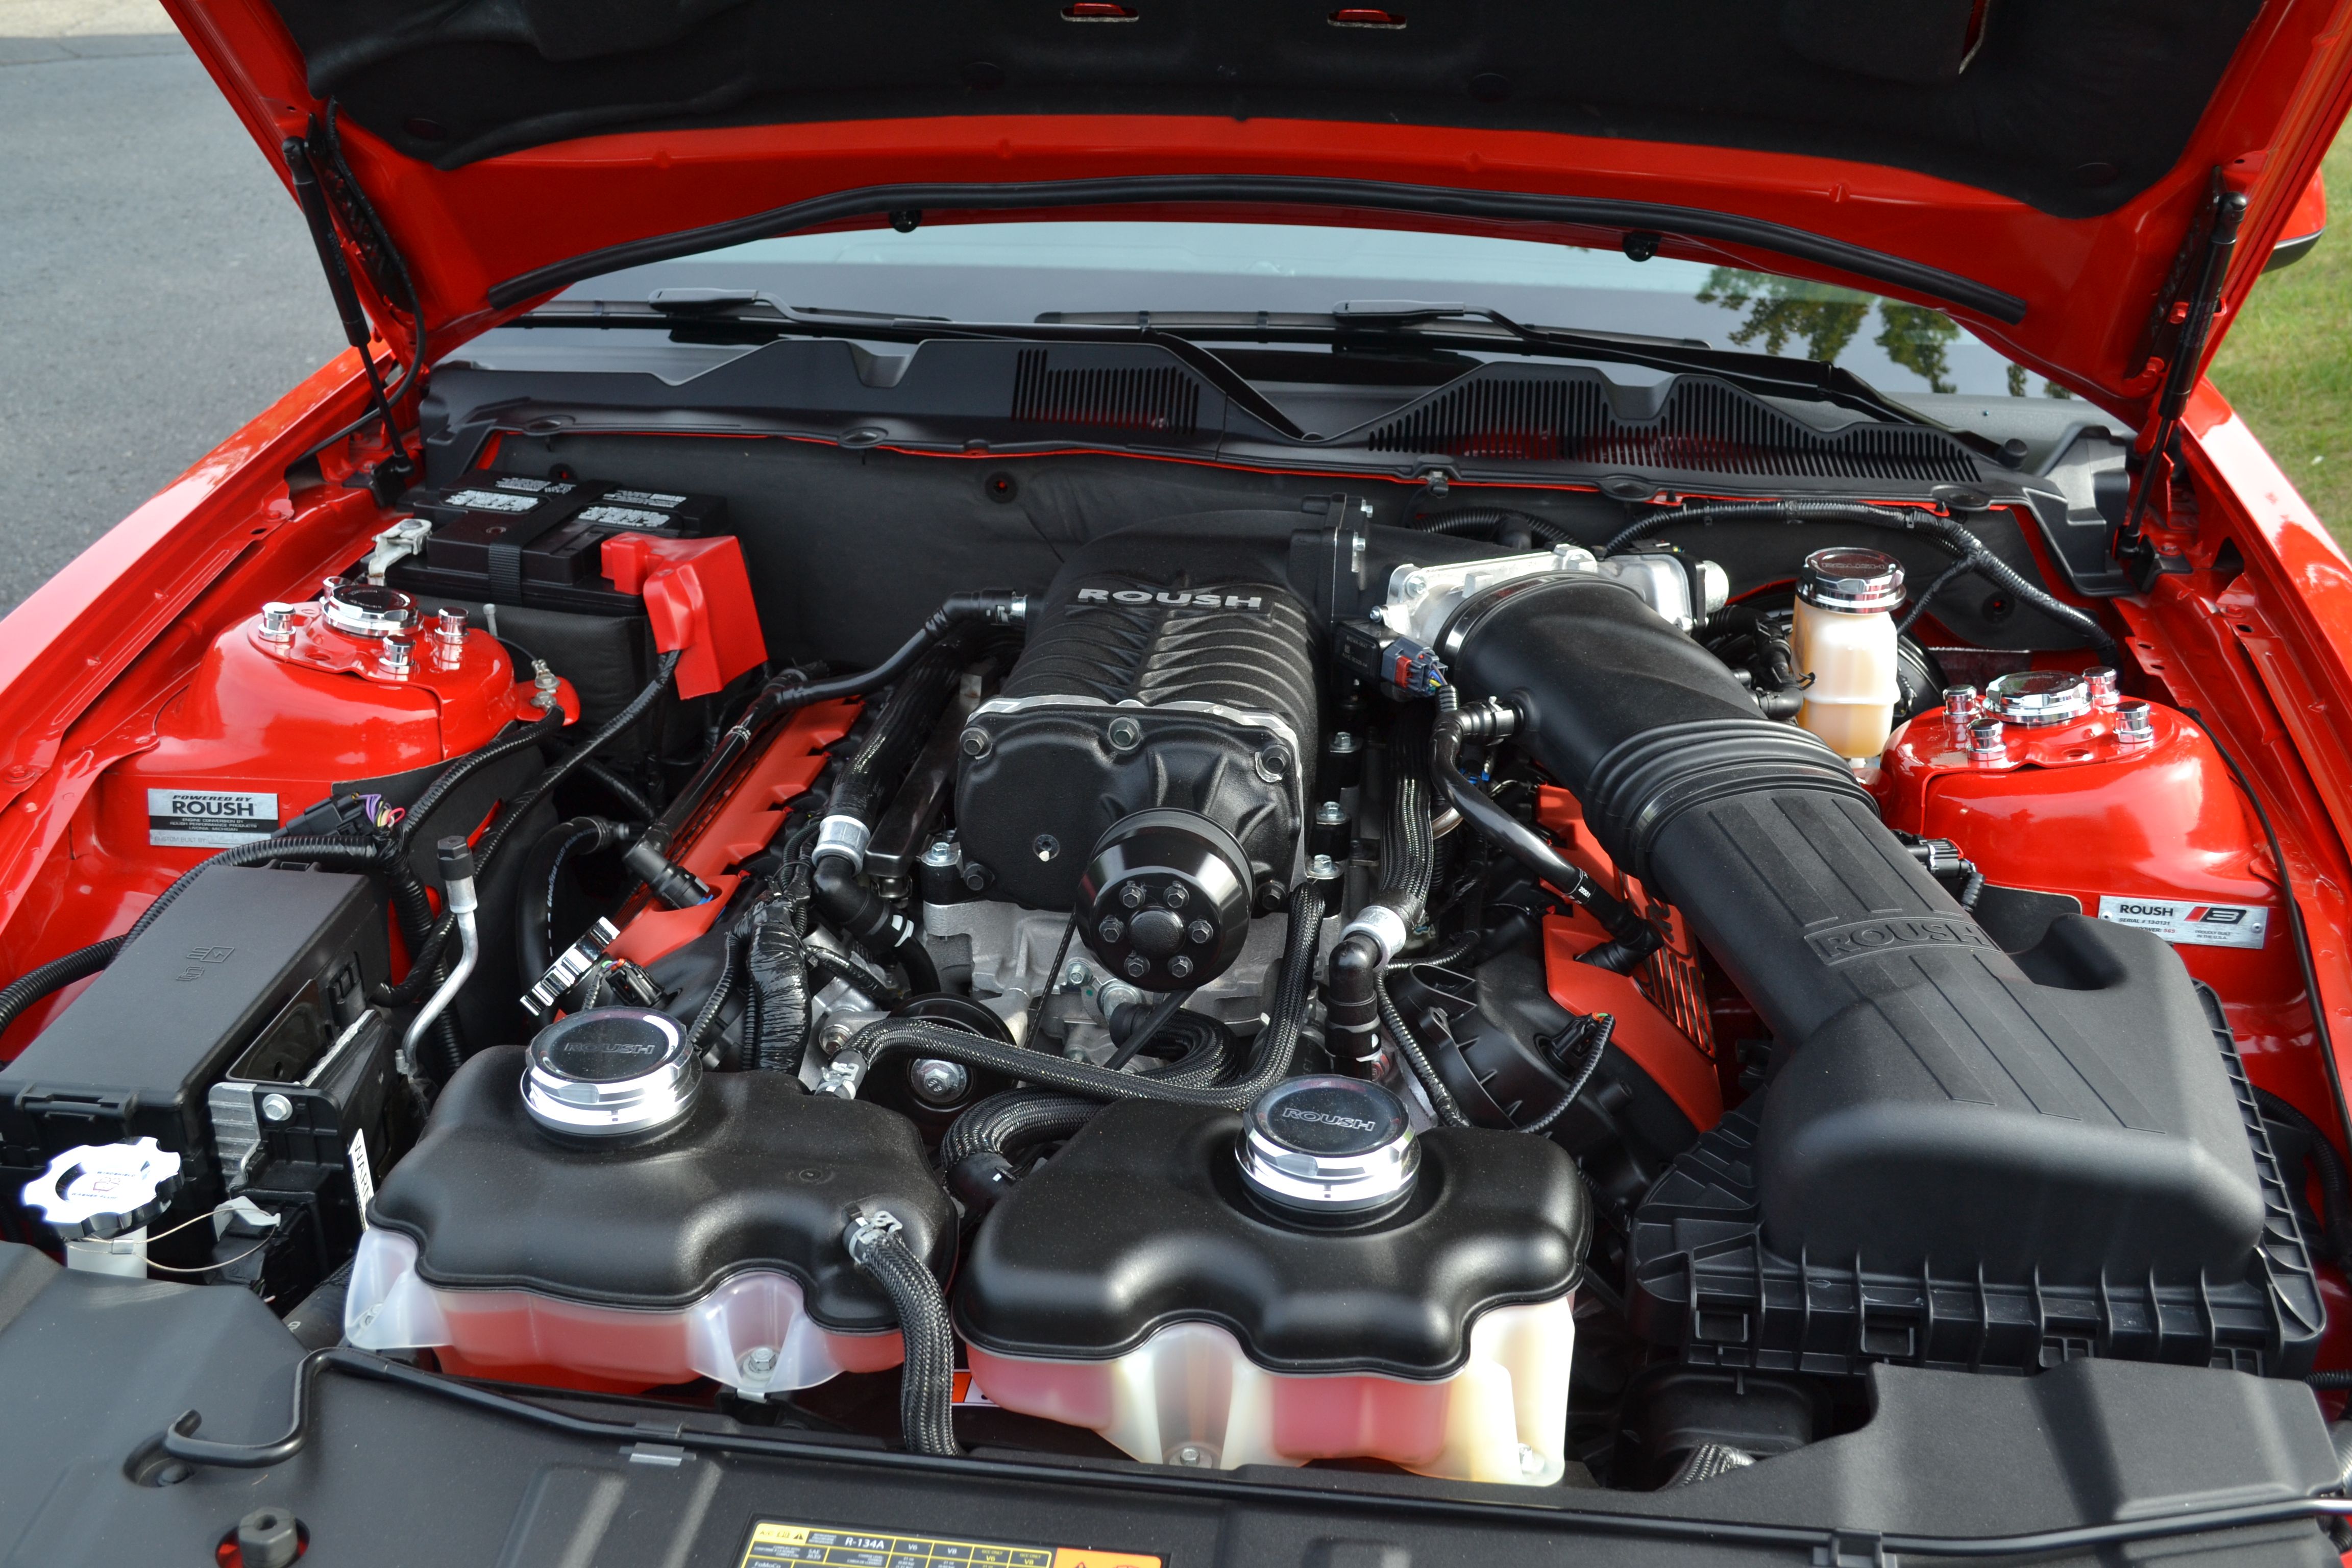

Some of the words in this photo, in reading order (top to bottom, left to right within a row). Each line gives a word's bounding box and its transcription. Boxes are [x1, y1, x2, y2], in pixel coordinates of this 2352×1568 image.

[1077, 589, 1262, 610] ROUSH
[172, 801, 254, 817] ROUSH
[2120, 904, 2173, 917] ROUSH
[1815, 922, 1991, 959] ROUSH
[564, 1042, 655, 1055] ROUSH
[1282, 1108, 1376, 1132] ROUSH
[355, 1136, 371, 1208] WARN
[845, 1536, 885, 1550] R-134A
[908, 1543, 918, 1551] V6
[947, 1547, 958, 1555] V8
